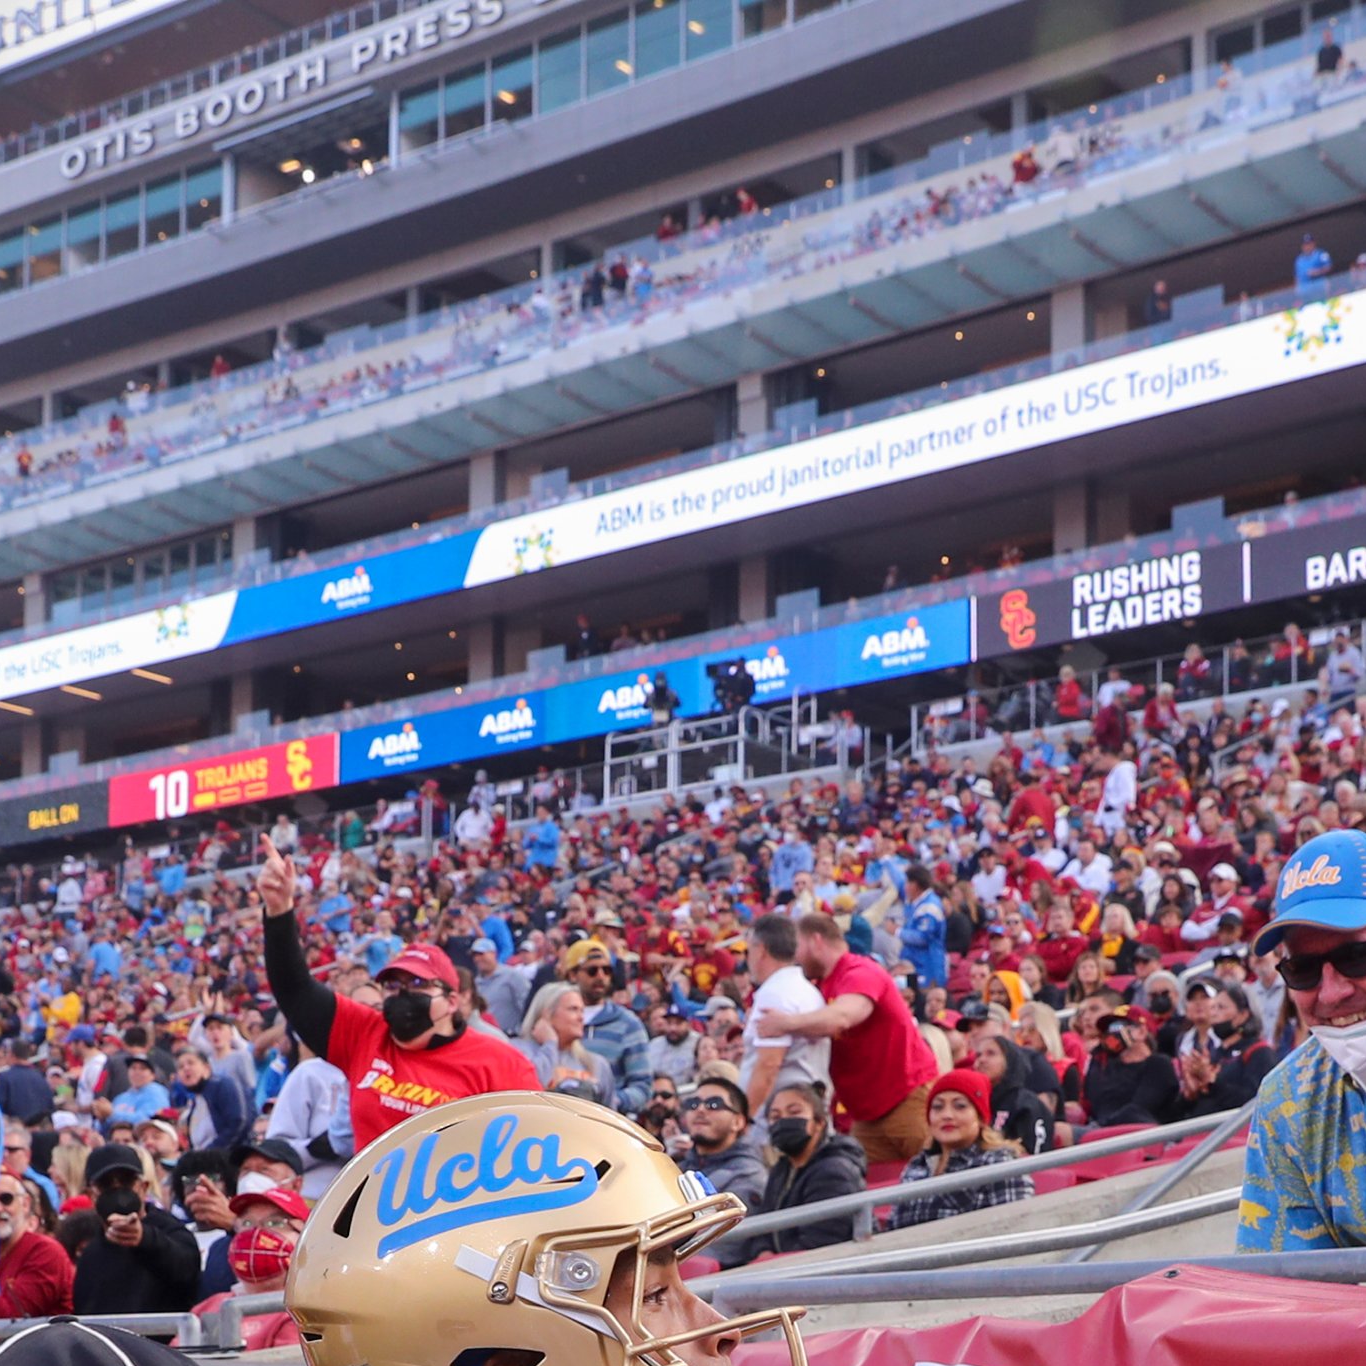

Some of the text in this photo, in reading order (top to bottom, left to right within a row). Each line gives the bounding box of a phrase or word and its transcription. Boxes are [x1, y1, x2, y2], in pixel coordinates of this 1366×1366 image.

[60, 0, 505, 179] OTIS BOOTH PRESS
[596, 356, 1229, 537] ABM is the proud janitorial partner of the USC Trojans.
[320, 573, 370, 605] ABM
[1072, 551, 1202, 607] RUSHING
[1071, 585, 1203, 640] LEADERS
[860, 625, 927, 660] ABM
[367, 730, 419, 761] ABM
[478, 706, 534, 738] ABM
[148, 769, 189, 820] 10
[195, 757, 268, 790] TROJANS
[1280, 854, 1343, 900] Ucla
[373, 1114, 598, 1252] Ucla
